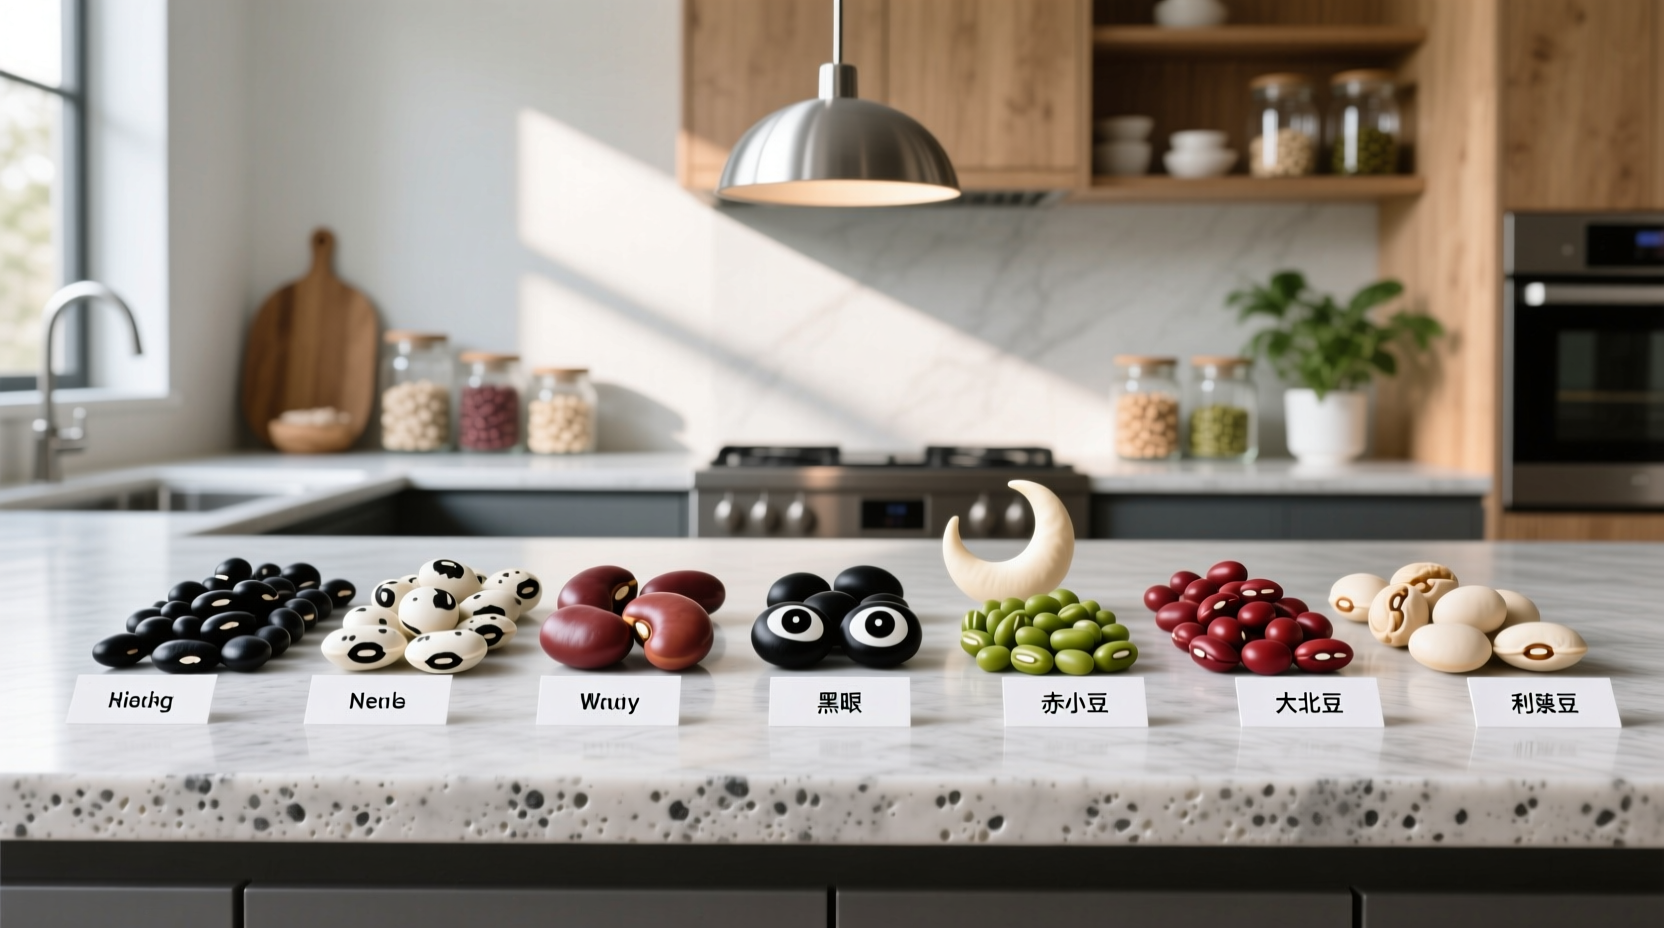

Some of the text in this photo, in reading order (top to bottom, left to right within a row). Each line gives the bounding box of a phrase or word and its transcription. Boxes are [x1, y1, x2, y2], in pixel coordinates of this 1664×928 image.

[1041, 691, 1109, 714] 赤小豆
[1275, 691, 1344, 714] 大北豆
